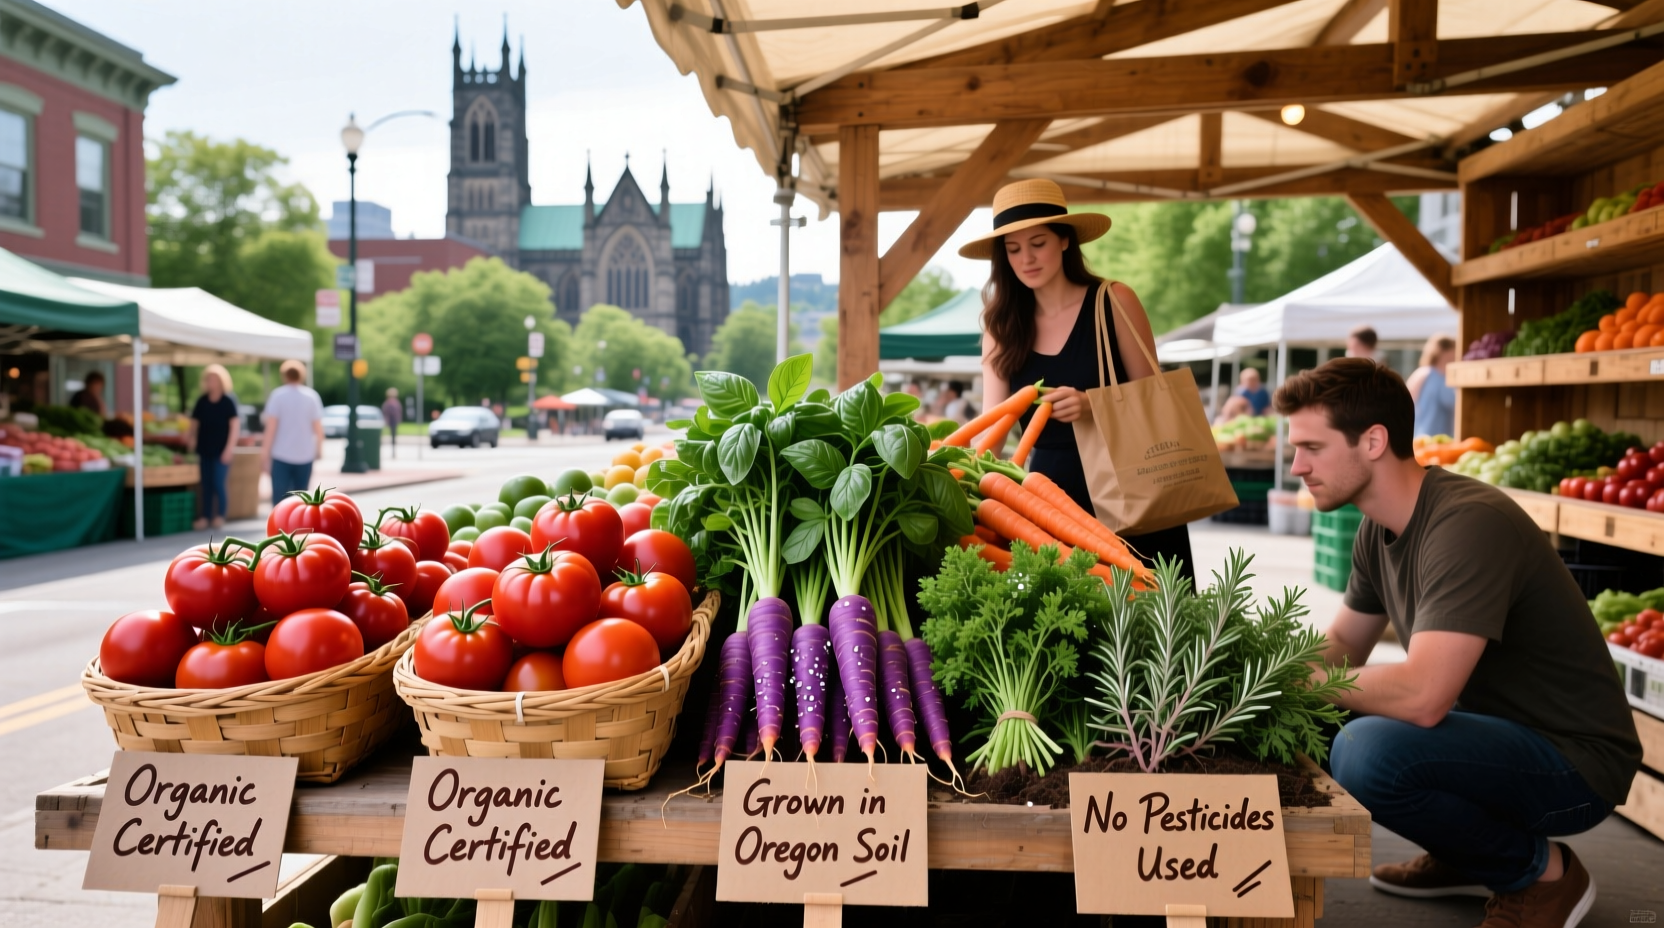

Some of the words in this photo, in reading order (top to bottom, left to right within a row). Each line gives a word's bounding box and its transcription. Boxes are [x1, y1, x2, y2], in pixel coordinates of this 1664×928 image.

[124, 763, 257, 821] Organic
[427, 768, 563, 827] Organic
[742, 777, 845, 818] Grown
[859, 787, 886, 815] in
[1083, 790, 1128, 834] No
[1138, 791, 1275, 835] Pesticides
[112, 817, 263, 873] Certified
[423, 820, 578, 877] Certified
[734, 825, 839, 881] Oregon
[852, 827, 911, 864] Soil
[1137, 842, 1219, 882] Used
